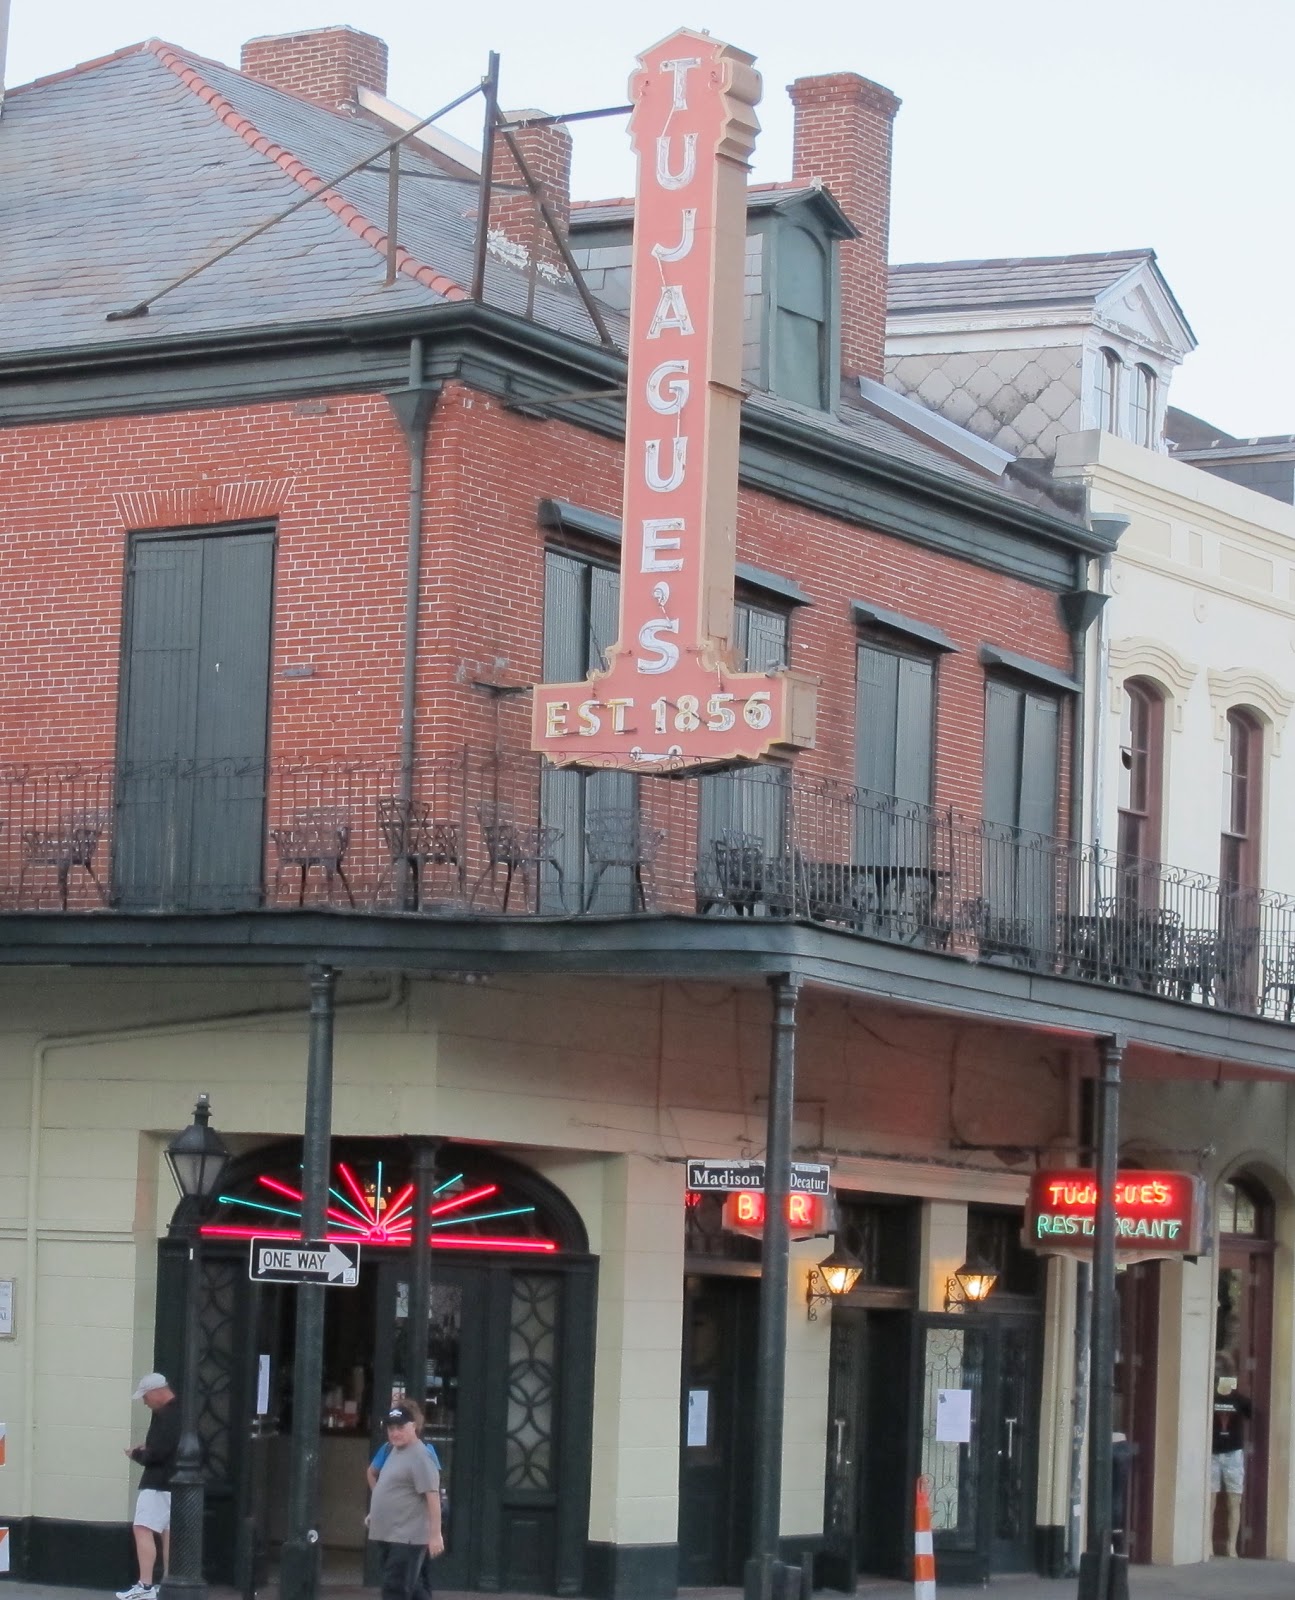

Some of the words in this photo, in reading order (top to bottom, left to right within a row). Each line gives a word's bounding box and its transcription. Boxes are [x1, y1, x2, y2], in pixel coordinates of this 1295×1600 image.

[636, 57, 701, 675] TUJAGUE'S
[545, 698, 633, 738] EST
[651, 691, 772, 734] 1856
[693, 1169, 760, 1186] Madison
[790, 1174, 826, 1190] Decatur
[738, 1193, 809, 1223] BR
[1037, 1214, 1182, 1239] RESTRANT
[263, 1251, 292, 1268] ONE
[297, 1252, 327, 1270] WAY
